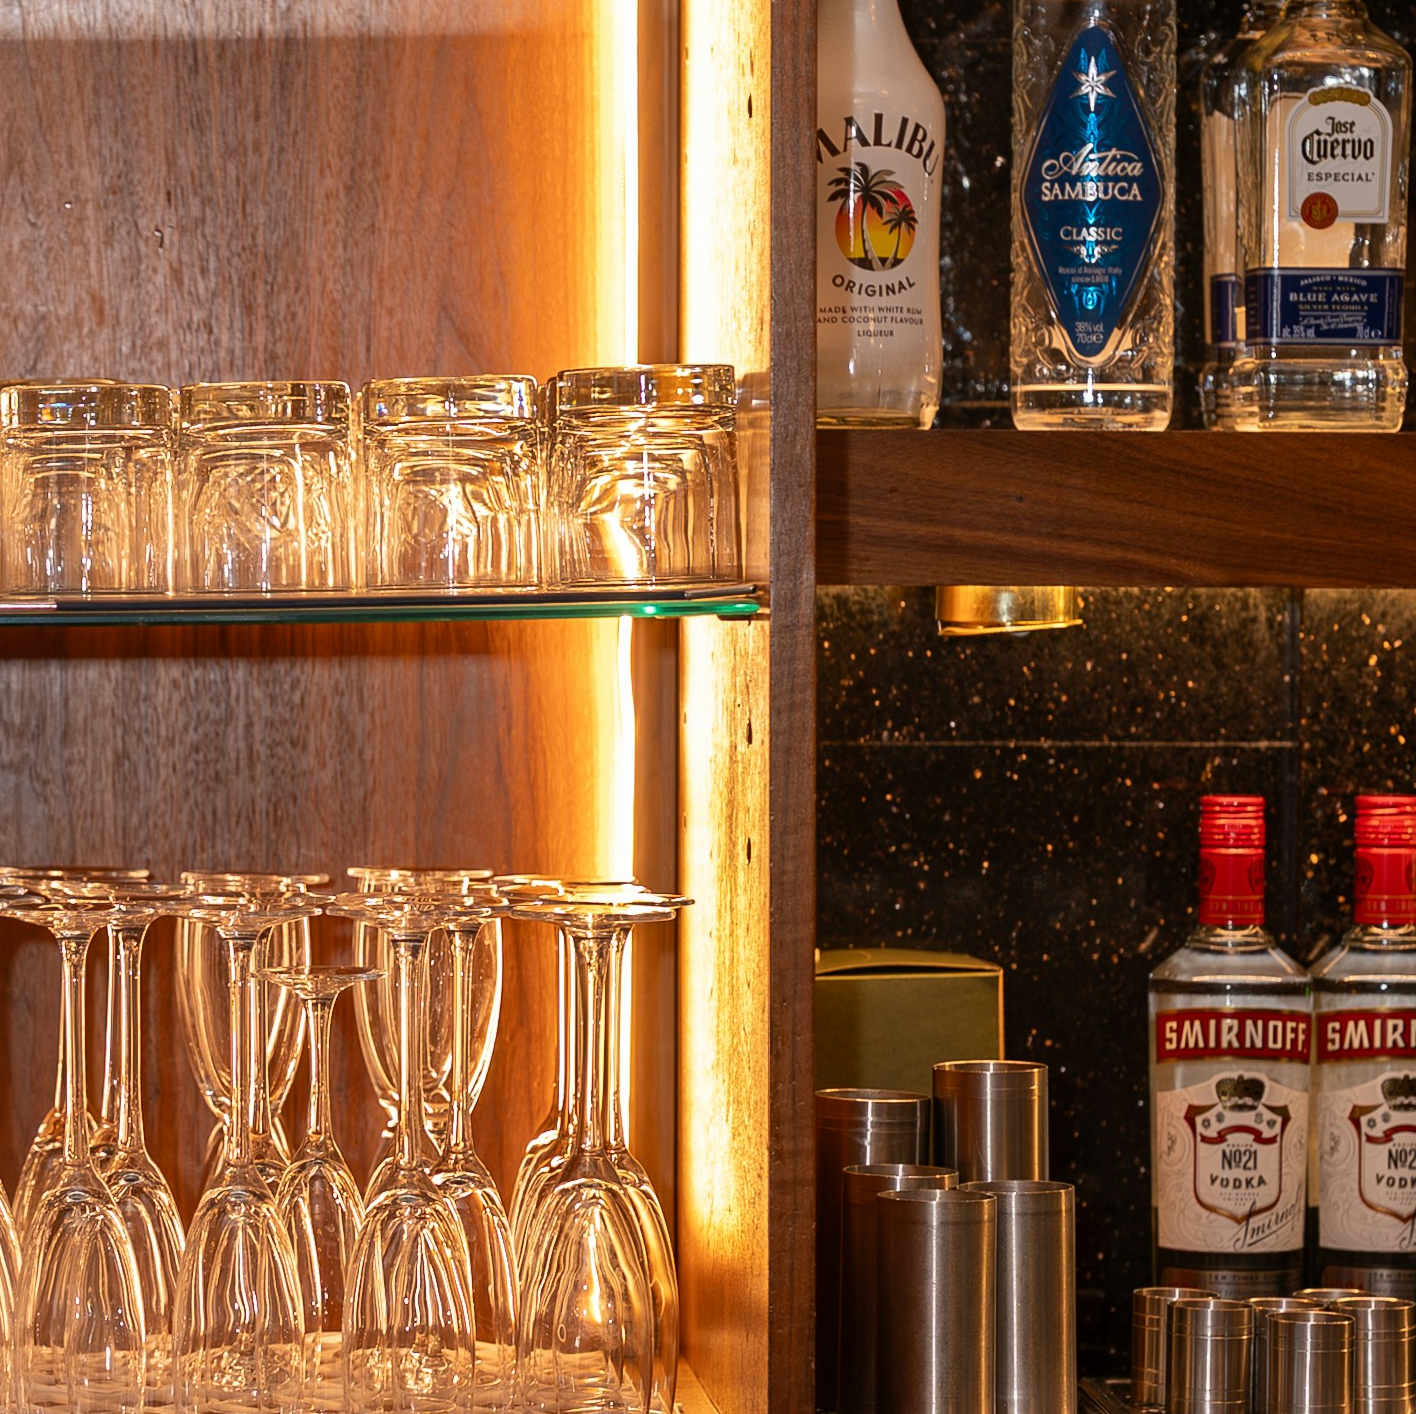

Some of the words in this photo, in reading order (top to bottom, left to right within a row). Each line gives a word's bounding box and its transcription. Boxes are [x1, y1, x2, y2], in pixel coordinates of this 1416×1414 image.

[1301, 128, 1374, 165] Cuervo
[1041, 142, 1143, 179] Antica
[1307, 172, 1372, 182] ESPECIAL
[1041, 181, 1143, 201] SAMBUCA
[1060, 226, 1123, 241] CLASSIC
[831, 274, 915, 297] ORIGINAL
[1300, 275, 1331, 286] JALISCO
[1338, 275, 1367, 286] MEXICO
[1289, 293, 1326, 302] BLUE
[1331, 293, 1378, 302] AGAVE
[819, 306, 848, 315] MADE
[850, 306, 874, 314] WITH
[877, 306, 904, 315] WHITE
[907, 307, 922, 316] RUM
[817, 316, 838, 324] AND
[841, 316, 888, 324] COCONUT
[890, 316, 923, 325] FLAVOUR
[1165, 1018, 1307, 1052] SMIRNOFF
[1210, 1173, 1267, 1189] VODKA
